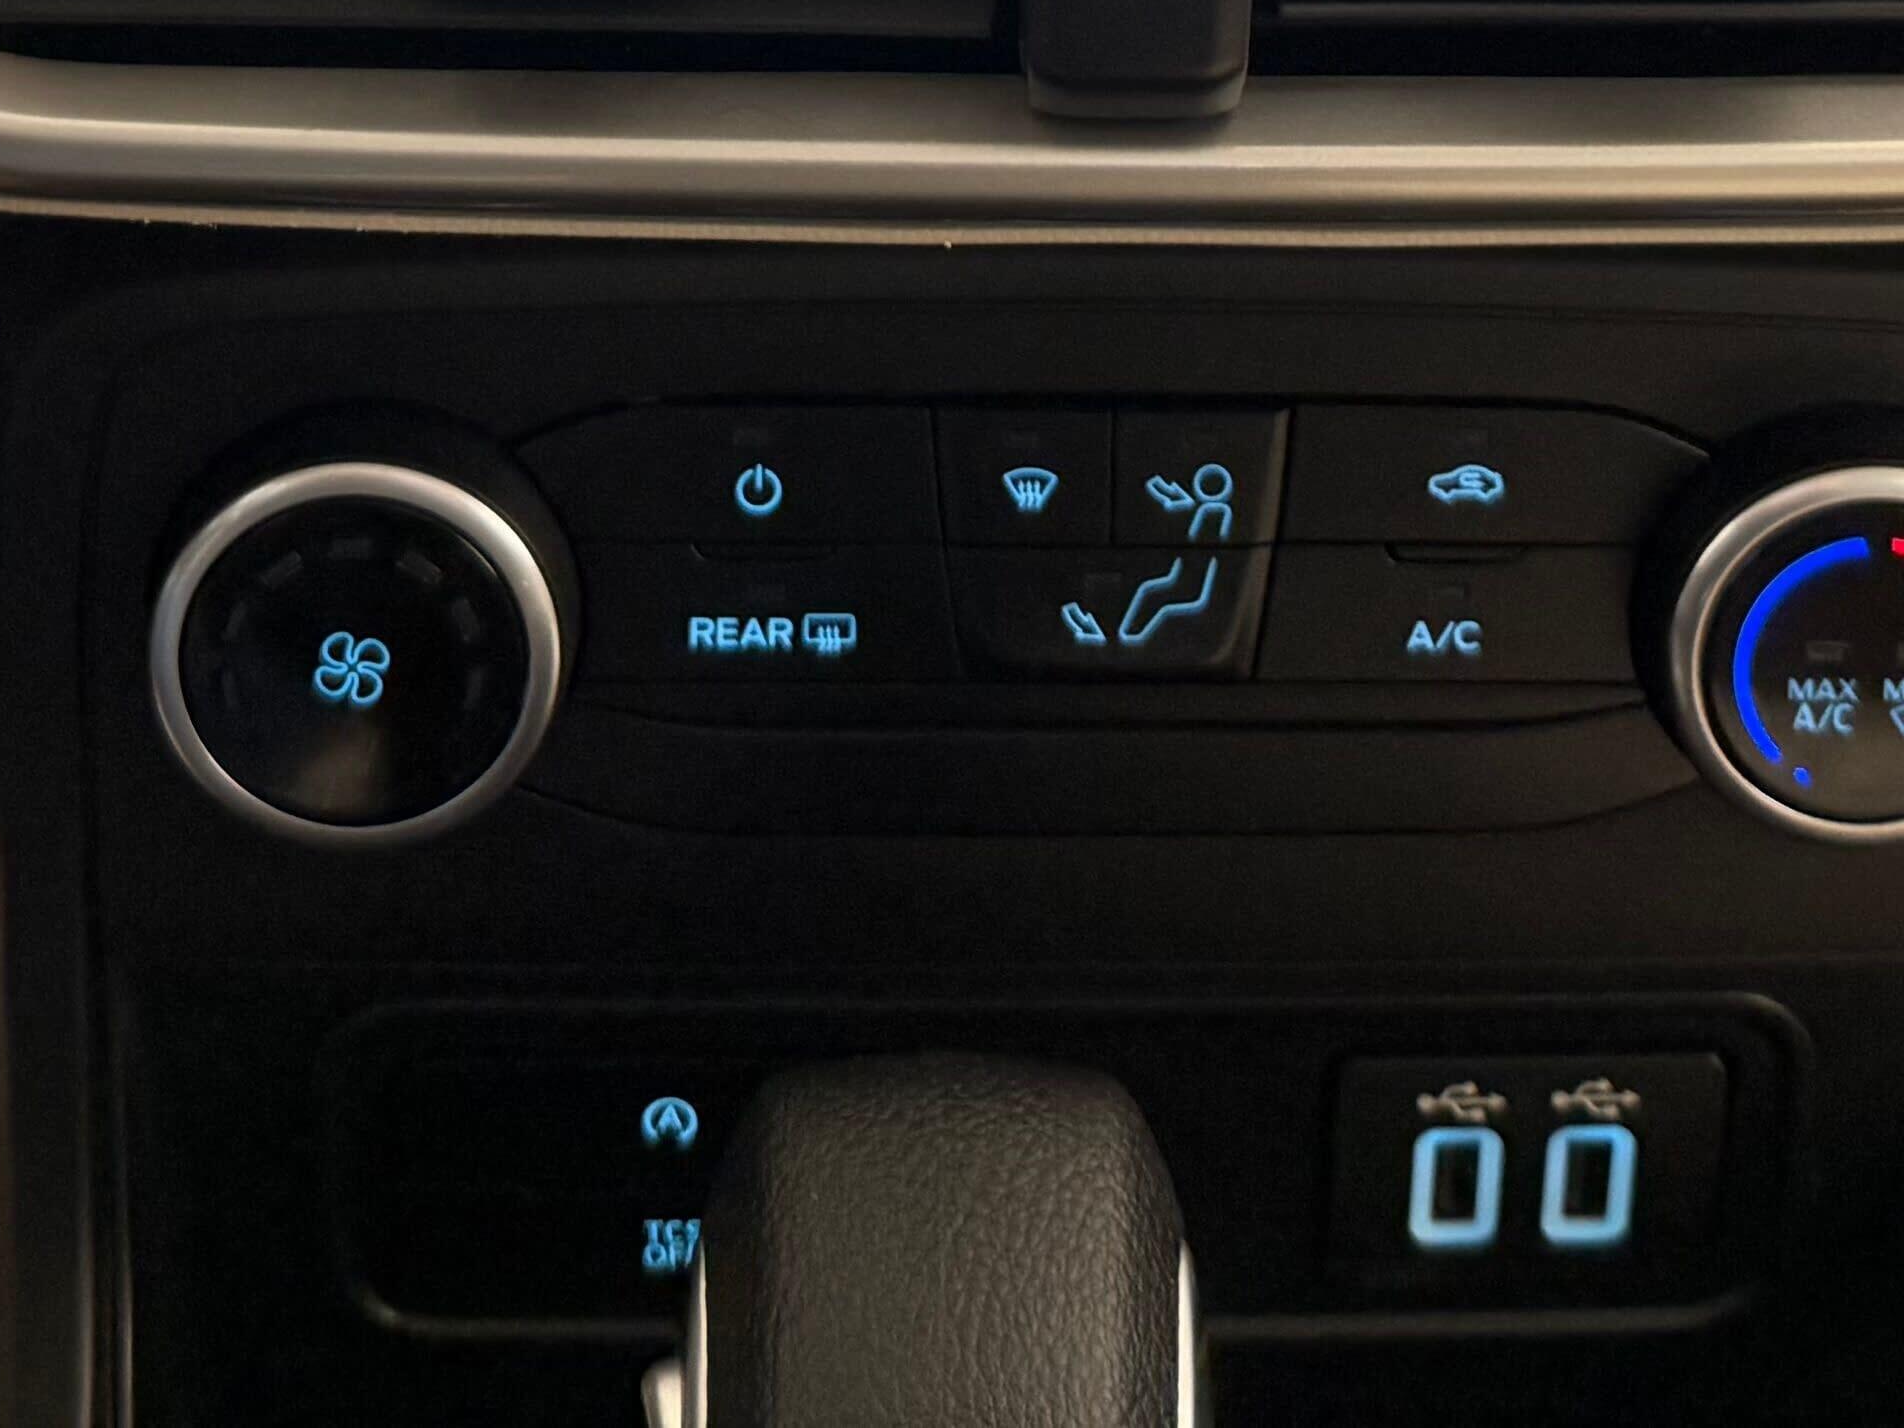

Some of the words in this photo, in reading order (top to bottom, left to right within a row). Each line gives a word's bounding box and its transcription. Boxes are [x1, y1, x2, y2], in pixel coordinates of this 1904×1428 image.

[688, 616, 794, 651] REAR
[1406, 620, 1480, 654] A/C
[1787, 678, 1859, 702] MAX
[1793, 702, 1854, 734] A/C
